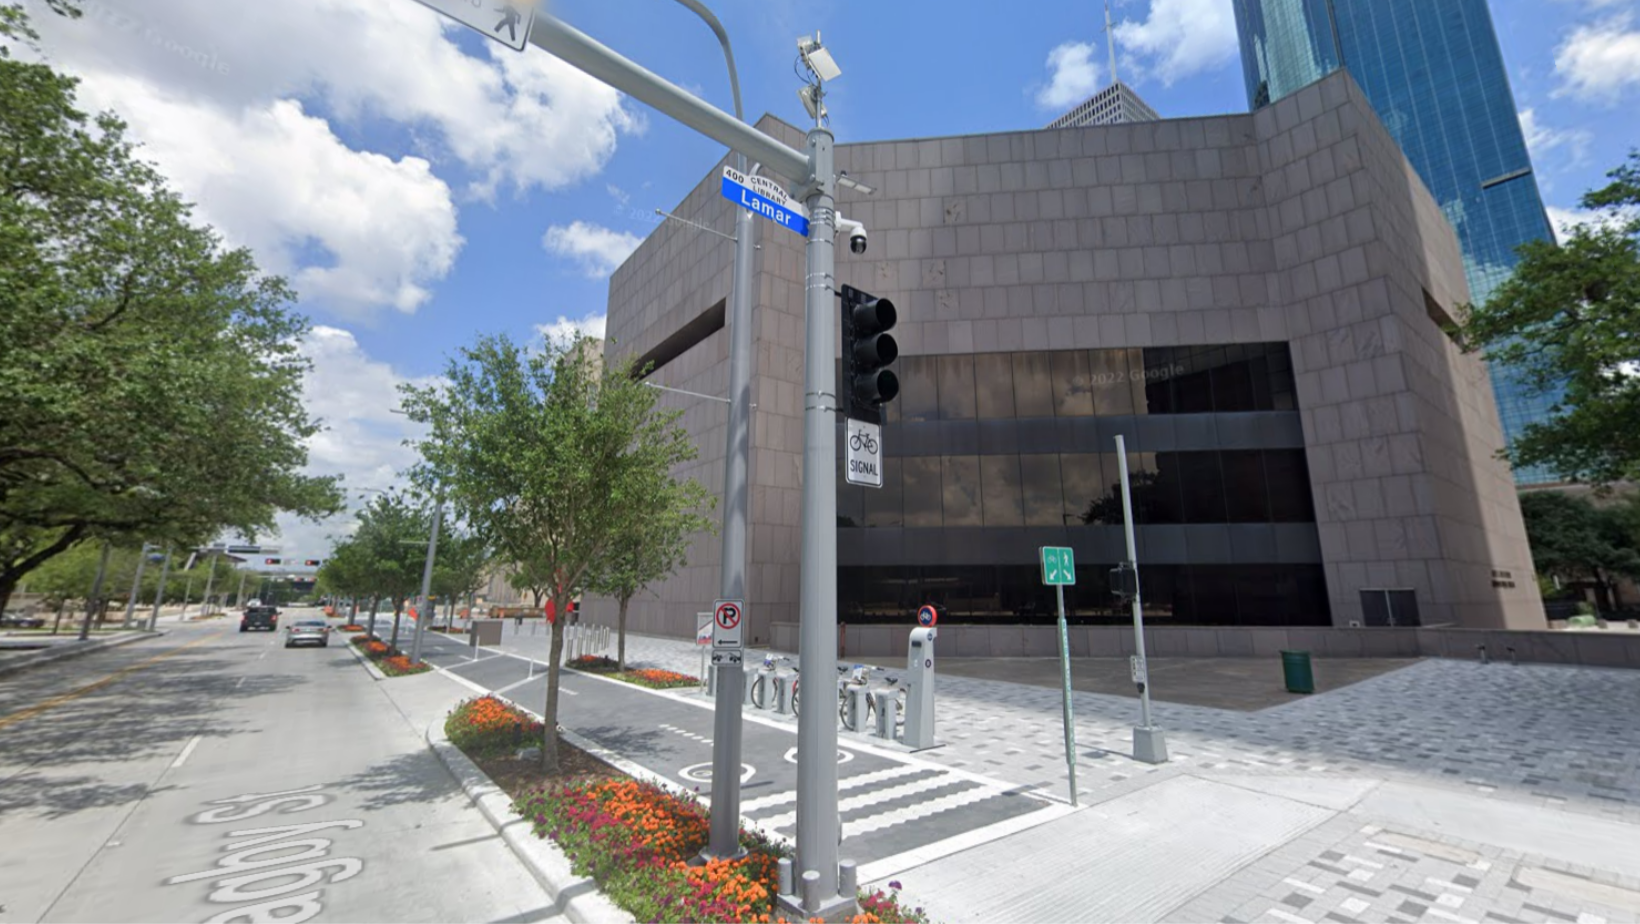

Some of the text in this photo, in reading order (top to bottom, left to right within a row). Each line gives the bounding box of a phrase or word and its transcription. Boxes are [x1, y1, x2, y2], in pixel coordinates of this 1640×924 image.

[726, 169, 744, 184] 400
[750, 177, 788, 201] CENTRAL
[752, 186, 786, 206] LIBRARY
[741, 189, 792, 225] Lamar
[850, 459, 878, 476] SIGNAL
